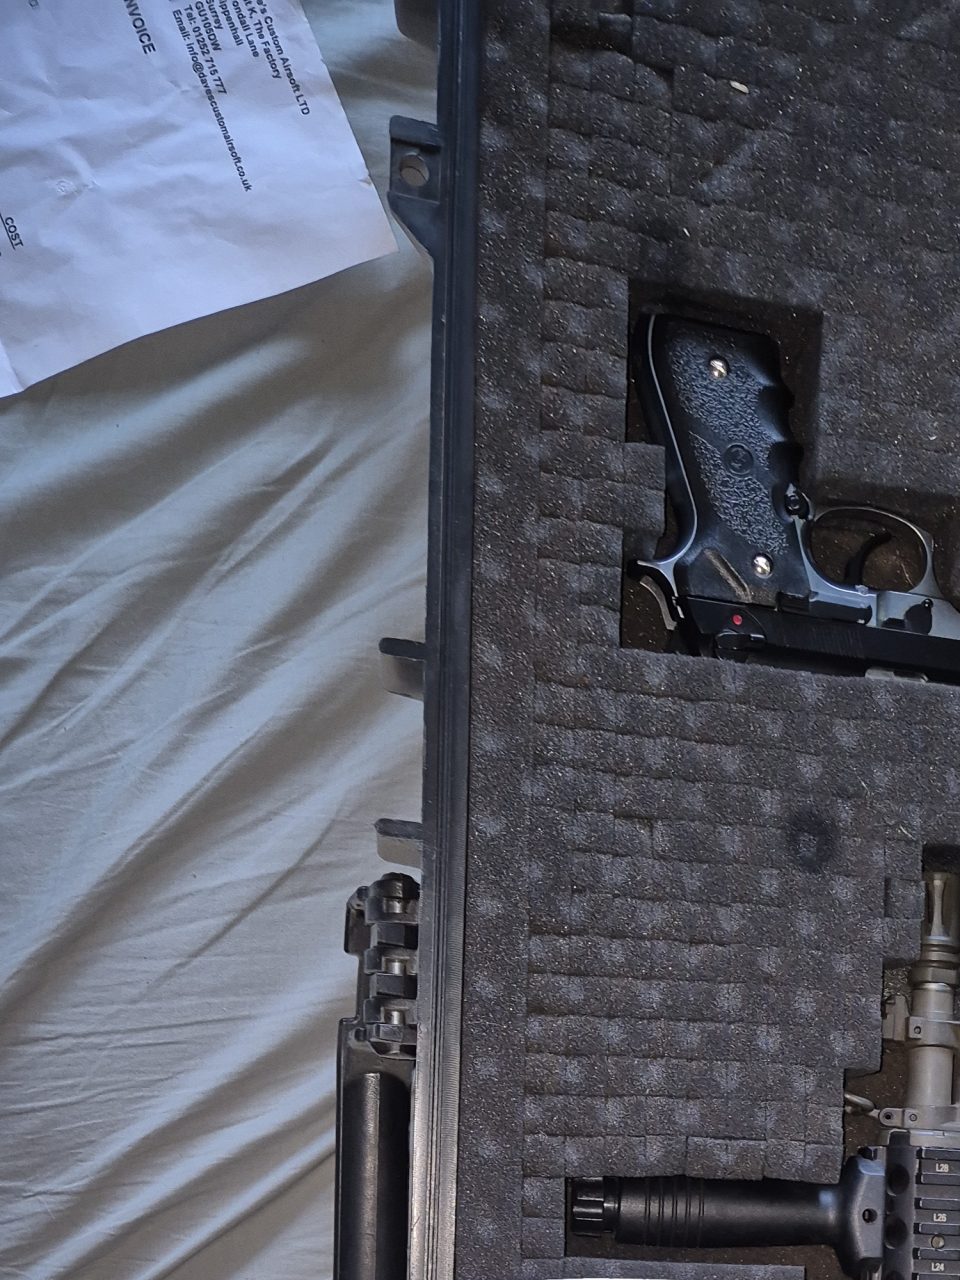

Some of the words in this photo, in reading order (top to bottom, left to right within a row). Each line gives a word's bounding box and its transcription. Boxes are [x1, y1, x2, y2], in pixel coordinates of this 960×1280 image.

[184, 4, 197, 26] Tel:
[192, 26, 210, 57] 01252
[205, 57, 218, 77] 715
[213, 76, 228, 95] 777
[245, 33, 259, 58] Lane
[253, 19, 265, 40] The
[261, 41, 282, 79] Factory
[264, 16, 284, 55] Custom
[280, 57, 301, 94] Airsoft
[295, 94, 310, 116] LTD
[172, 9, 191, 41] Email:
[186, 42, 252, 192] info@davescustomairsoft.co.uk
[5, 216, 24, 247] COST
[931, 1262, 945, 1272] L24
